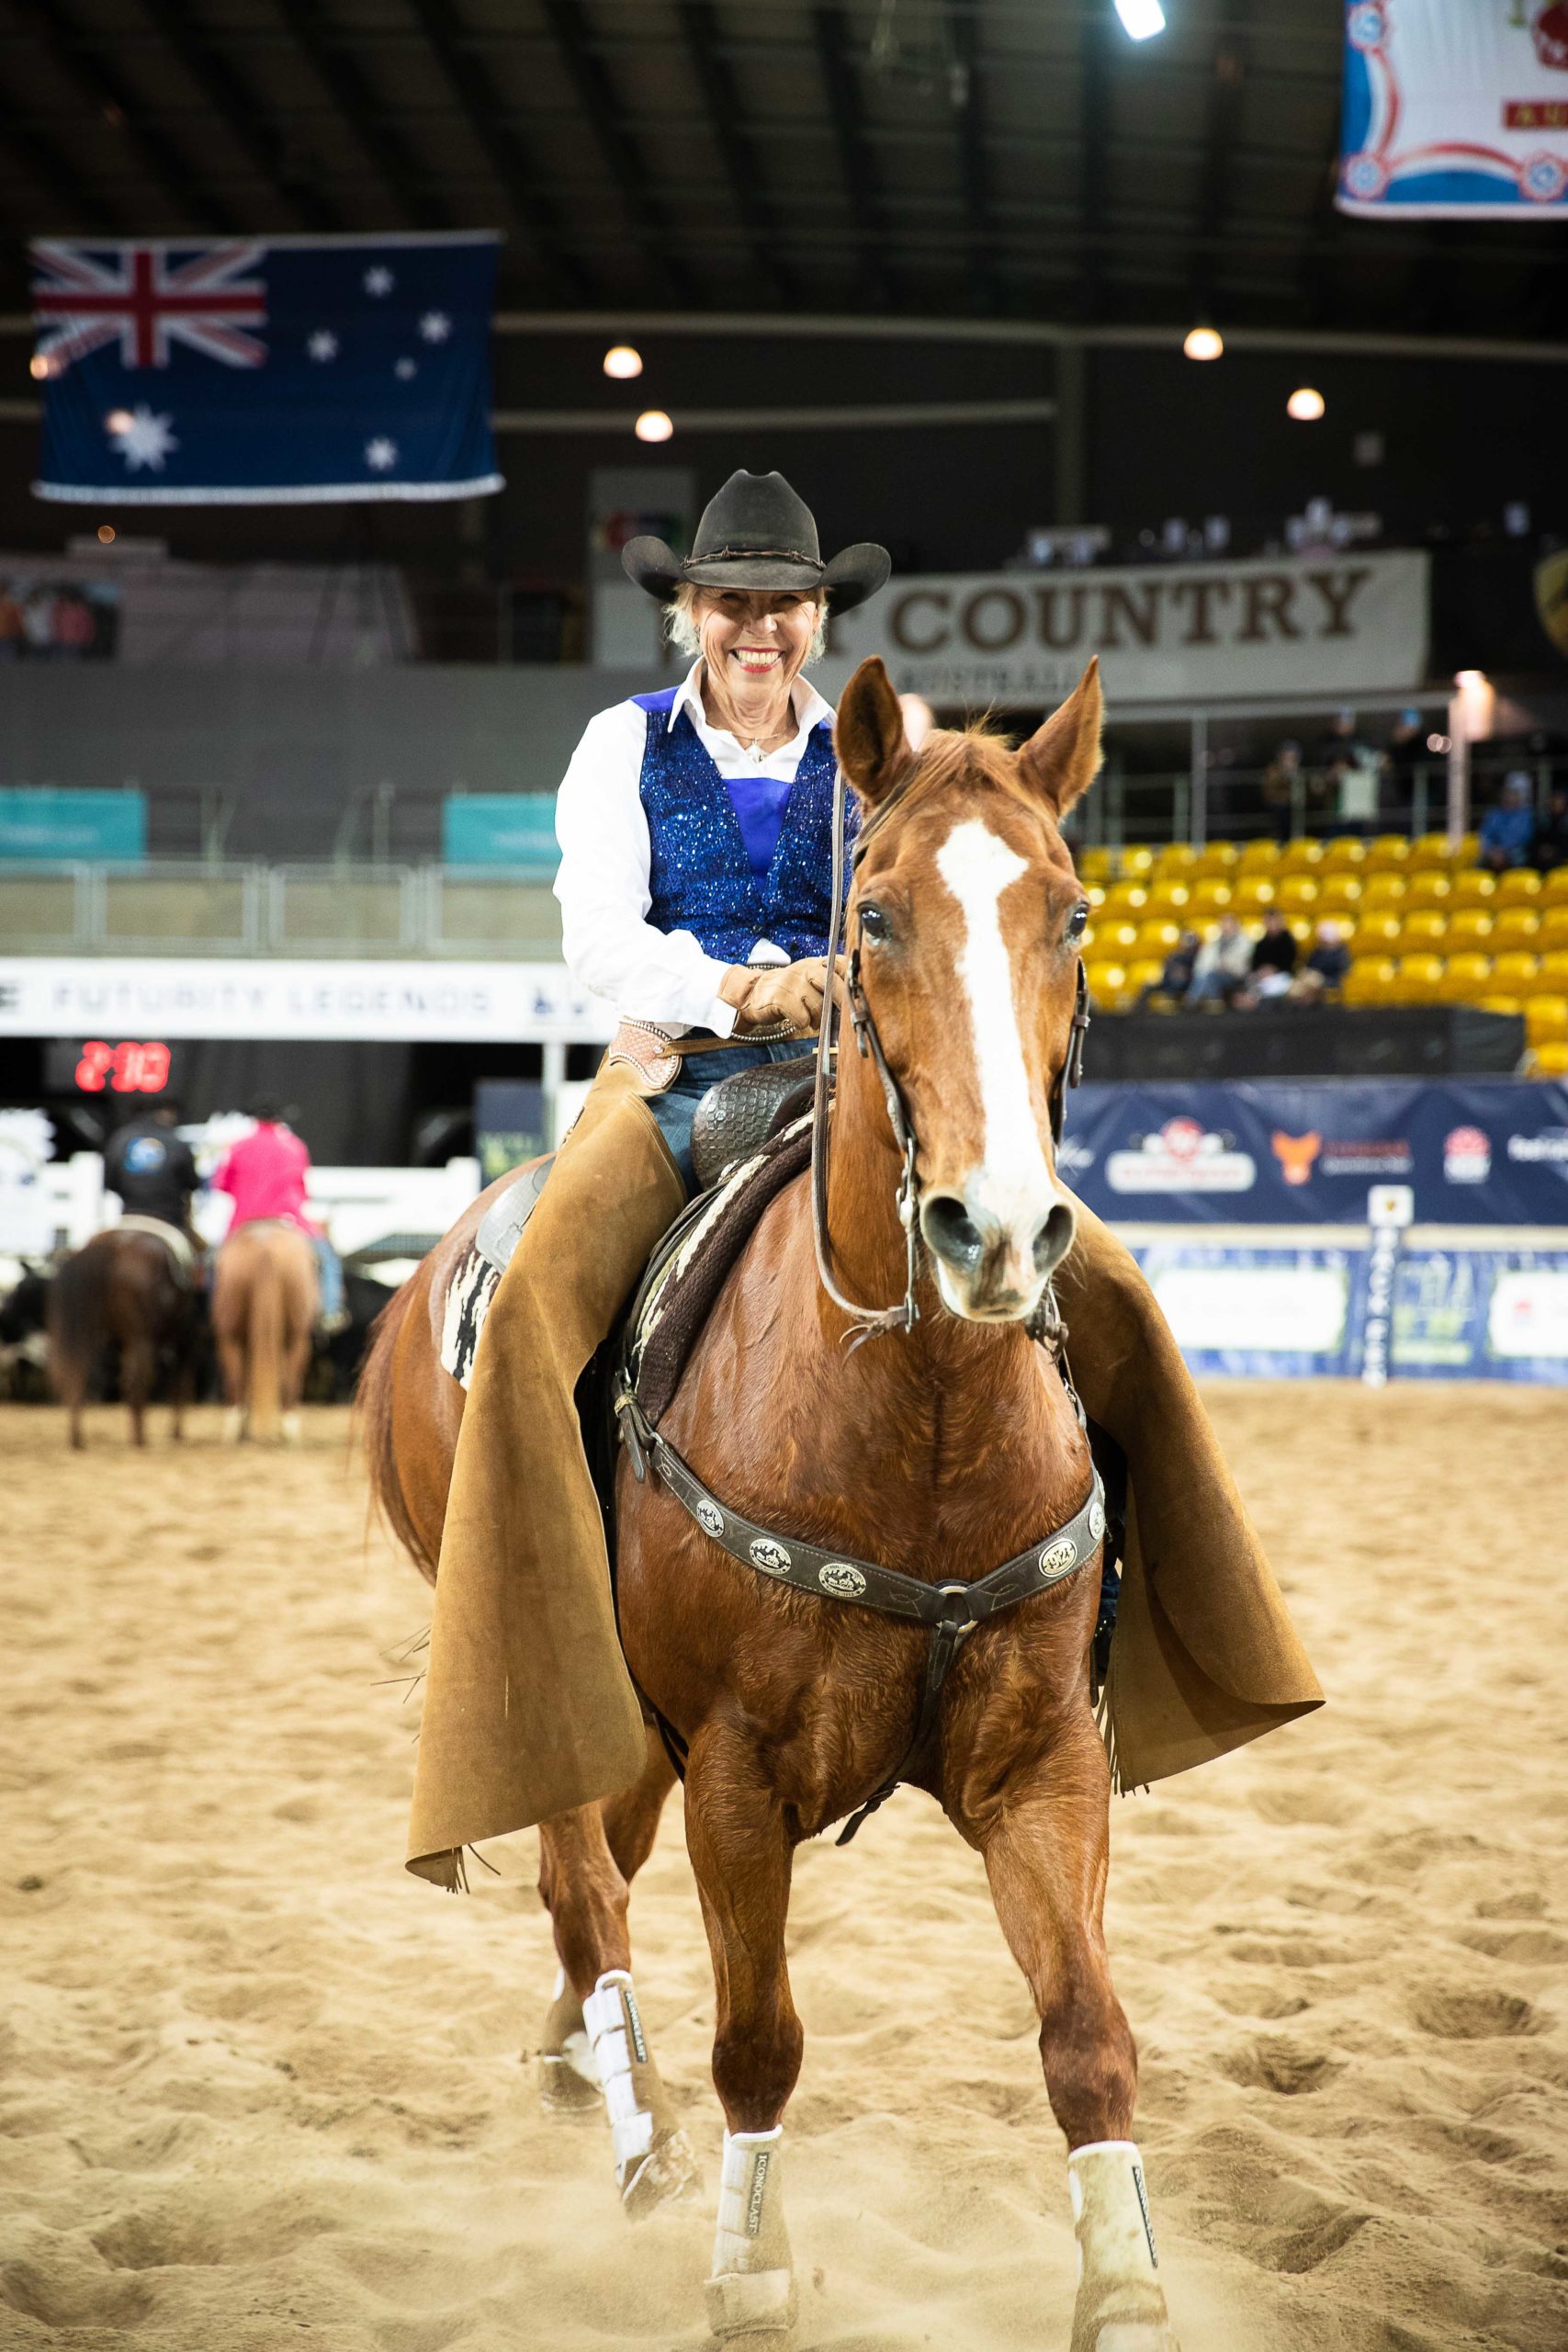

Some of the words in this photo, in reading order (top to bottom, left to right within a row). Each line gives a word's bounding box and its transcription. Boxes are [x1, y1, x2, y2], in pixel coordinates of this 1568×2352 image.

[887, 570, 1370, 653] COUNTRY
[52, 979, 267, 1016] FUTURITY
[287, 981, 491, 1018] LEGENDS
[749, 2154, 768, 2233] ICONOCLAST
